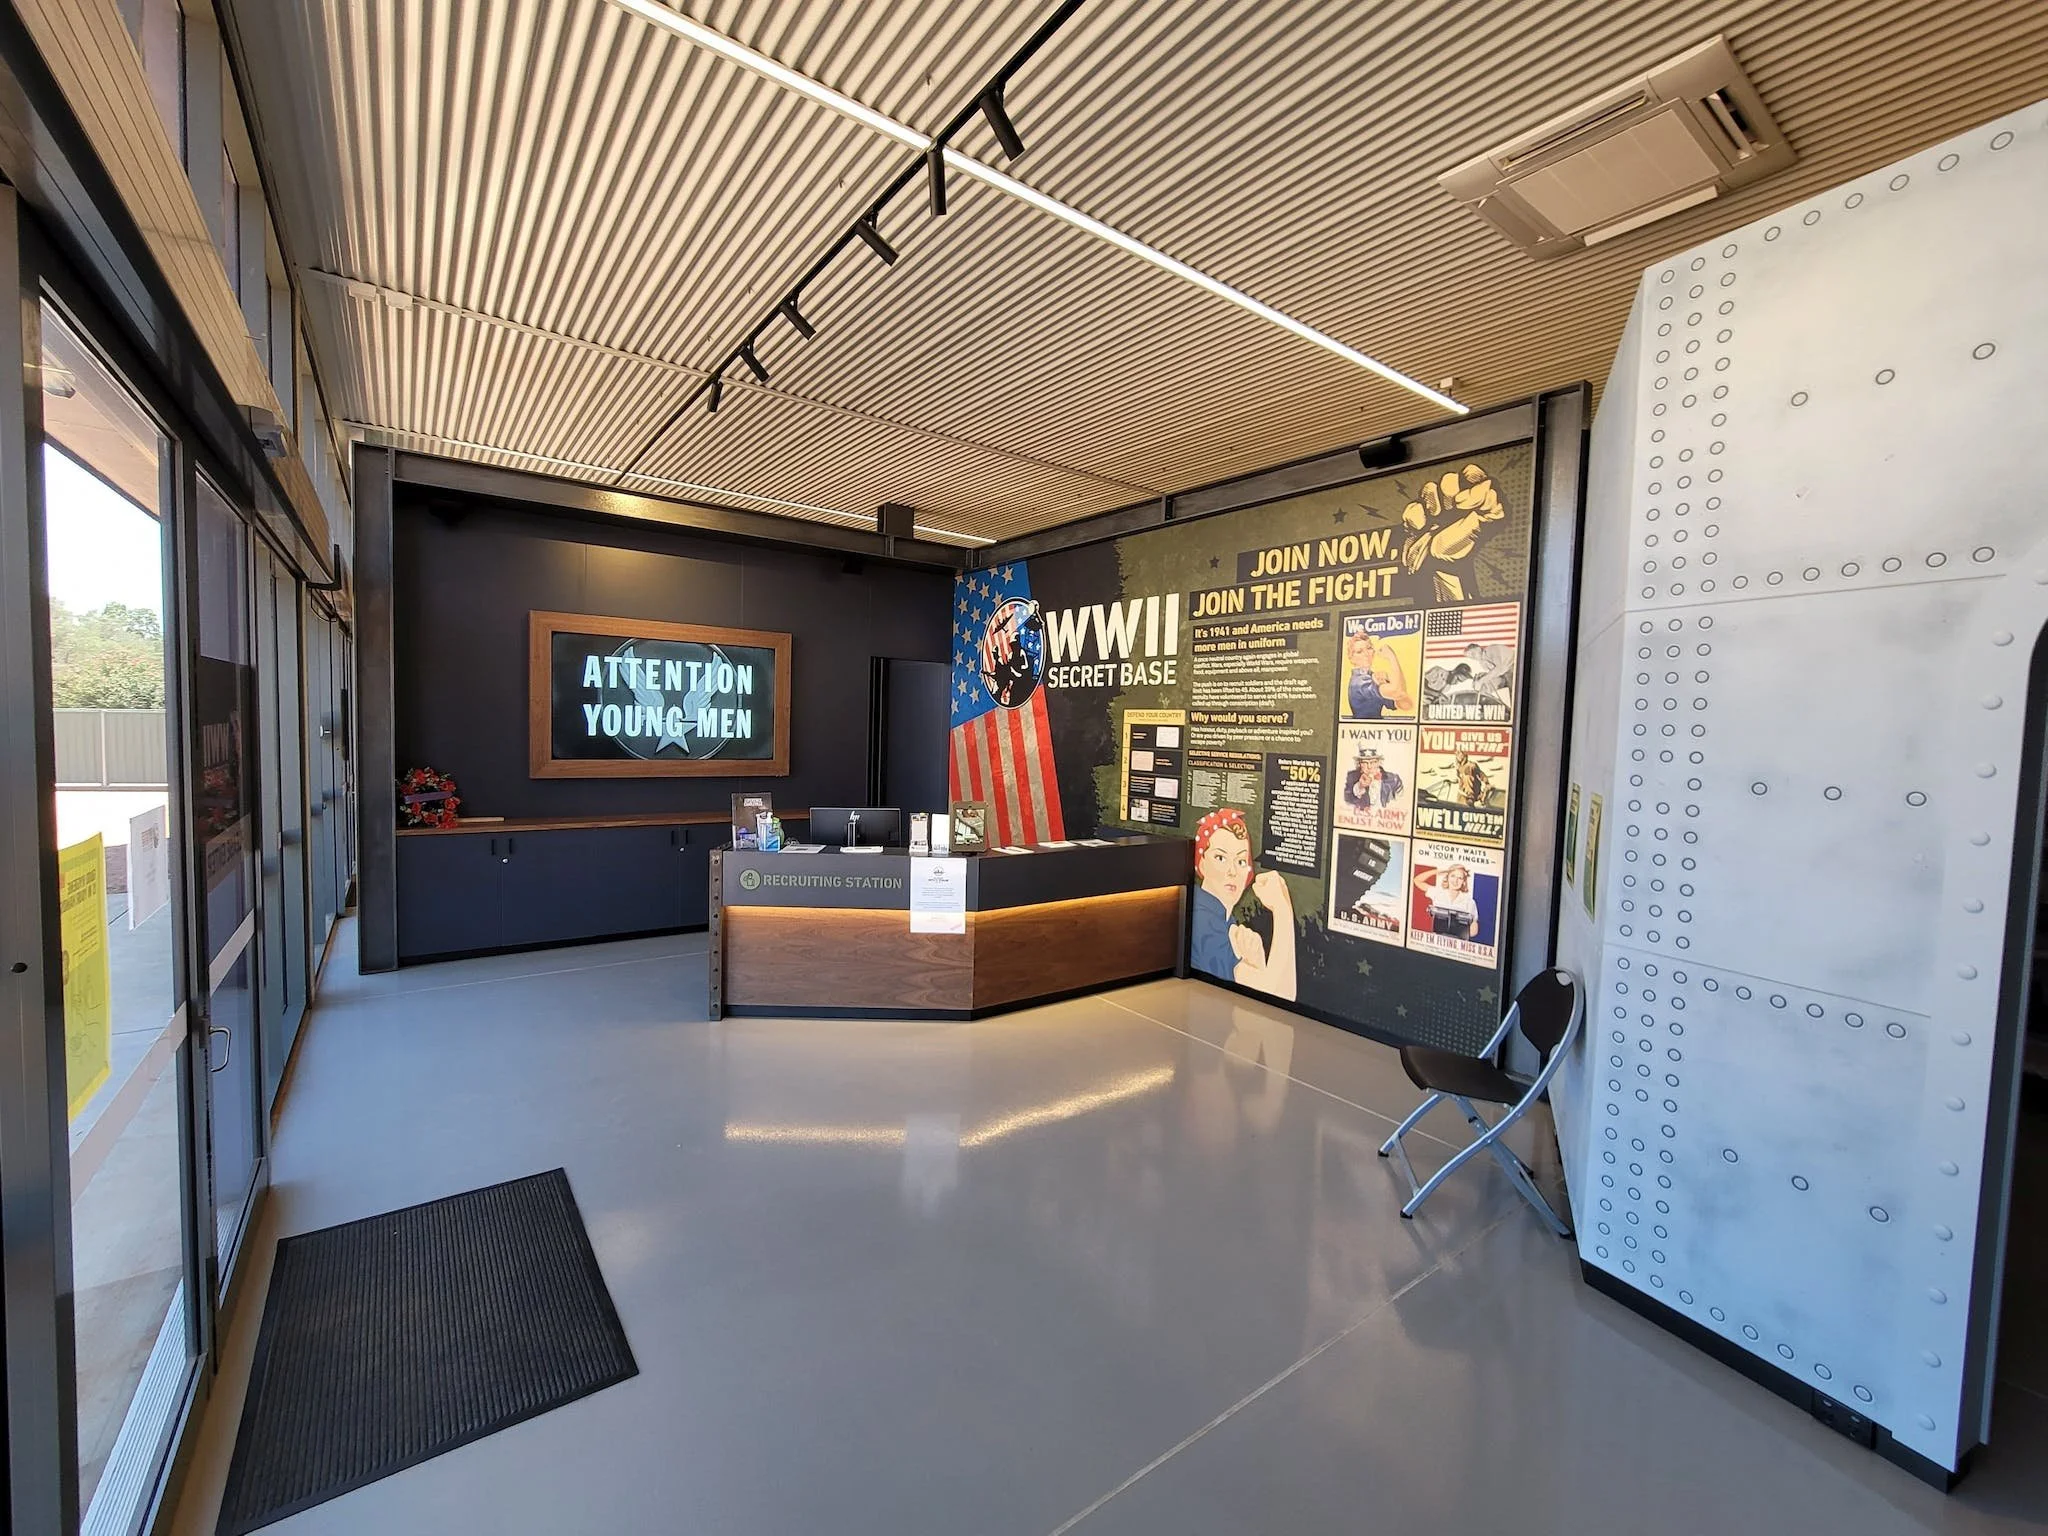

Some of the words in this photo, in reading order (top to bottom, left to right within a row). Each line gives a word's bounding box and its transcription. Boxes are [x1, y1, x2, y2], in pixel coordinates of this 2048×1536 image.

[1251, 543, 1310, 578] JOIN
[1319, 529, 1398, 567] NOW,
[1193, 588, 1244, 618] JOIN
[1251, 580, 1301, 610] THE
[1308, 567, 1398, 604] FIGHT
[1046, 593, 1179, 663] WWII
[1195, 629, 1208, 638] It's
[1210, 626, 1229, 637] 1941
[1232, 625, 1248, 635] and
[1250, 622, 1290, 634] America
[1292, 618, 1323, 630] needs
[1348, 620, 1364, 633] We
[1365, 618, 1385, 632] Can
[1387, 616, 1403, 630] Do
[1405, 614, 1419, 629] It!
[1195, 643, 1216, 652] more
[1218, 642, 1236, 650] men
[1238, 640, 1247, 649] in
[1248, 638, 1286, 648] uniform
[583, 655, 753, 694] ATTENTION
[1048, 664, 1116, 688] SECRET
[1120, 660, 1176, 686] BASE
[1191, 712, 1208, 723] Why
[1211, 712, 1236, 723] would
[1238, 715, 1255, 724] you
[1256, 712, 1289, 723] serve?
[1428, 704, 1464, 720] UNITED
[1465, 704, 1482, 720] WE
[1484, 705, 1505, 720] WIN
[583, 704, 682, 737] YOUNG
[697, 708, 751, 738] MEN
[1341, 730, 1345, 738] I
[1350, 730, 1382, 740] WANT
[1386, 729, 1411, 741] YOU
[1422, 731, 1455, 751] YOU
[1461, 732, 1484, 742] GIVE
[1487, 733, 1502, 742] US
[1290, 766, 1320, 782] 50%
[1338, 815, 1371, 827] ENLIST
[1377, 820, 1404, 830] NOW
[1375, 809, 1408, 821] ARMY
[1418, 807, 1462, 831] WE'LL
[1462, 812, 1485, 824] GIVE
[1464, 822, 1500, 835] HELL!
[1428, 843, 1460, 853] VICTORY
[1464, 849, 1486, 857] WAITS
[1434, 851, 1453, 860] YOUR
[764, 874, 841, 887] RECRUITING
[845, 877, 901, 889] STATION
[1341, 911, 1361, 923] U.S.
[1363, 916, 1392, 930] ARMY
[1411, 931, 1424, 941] KEEP
[1460, 940, 1475, 953] MISS
